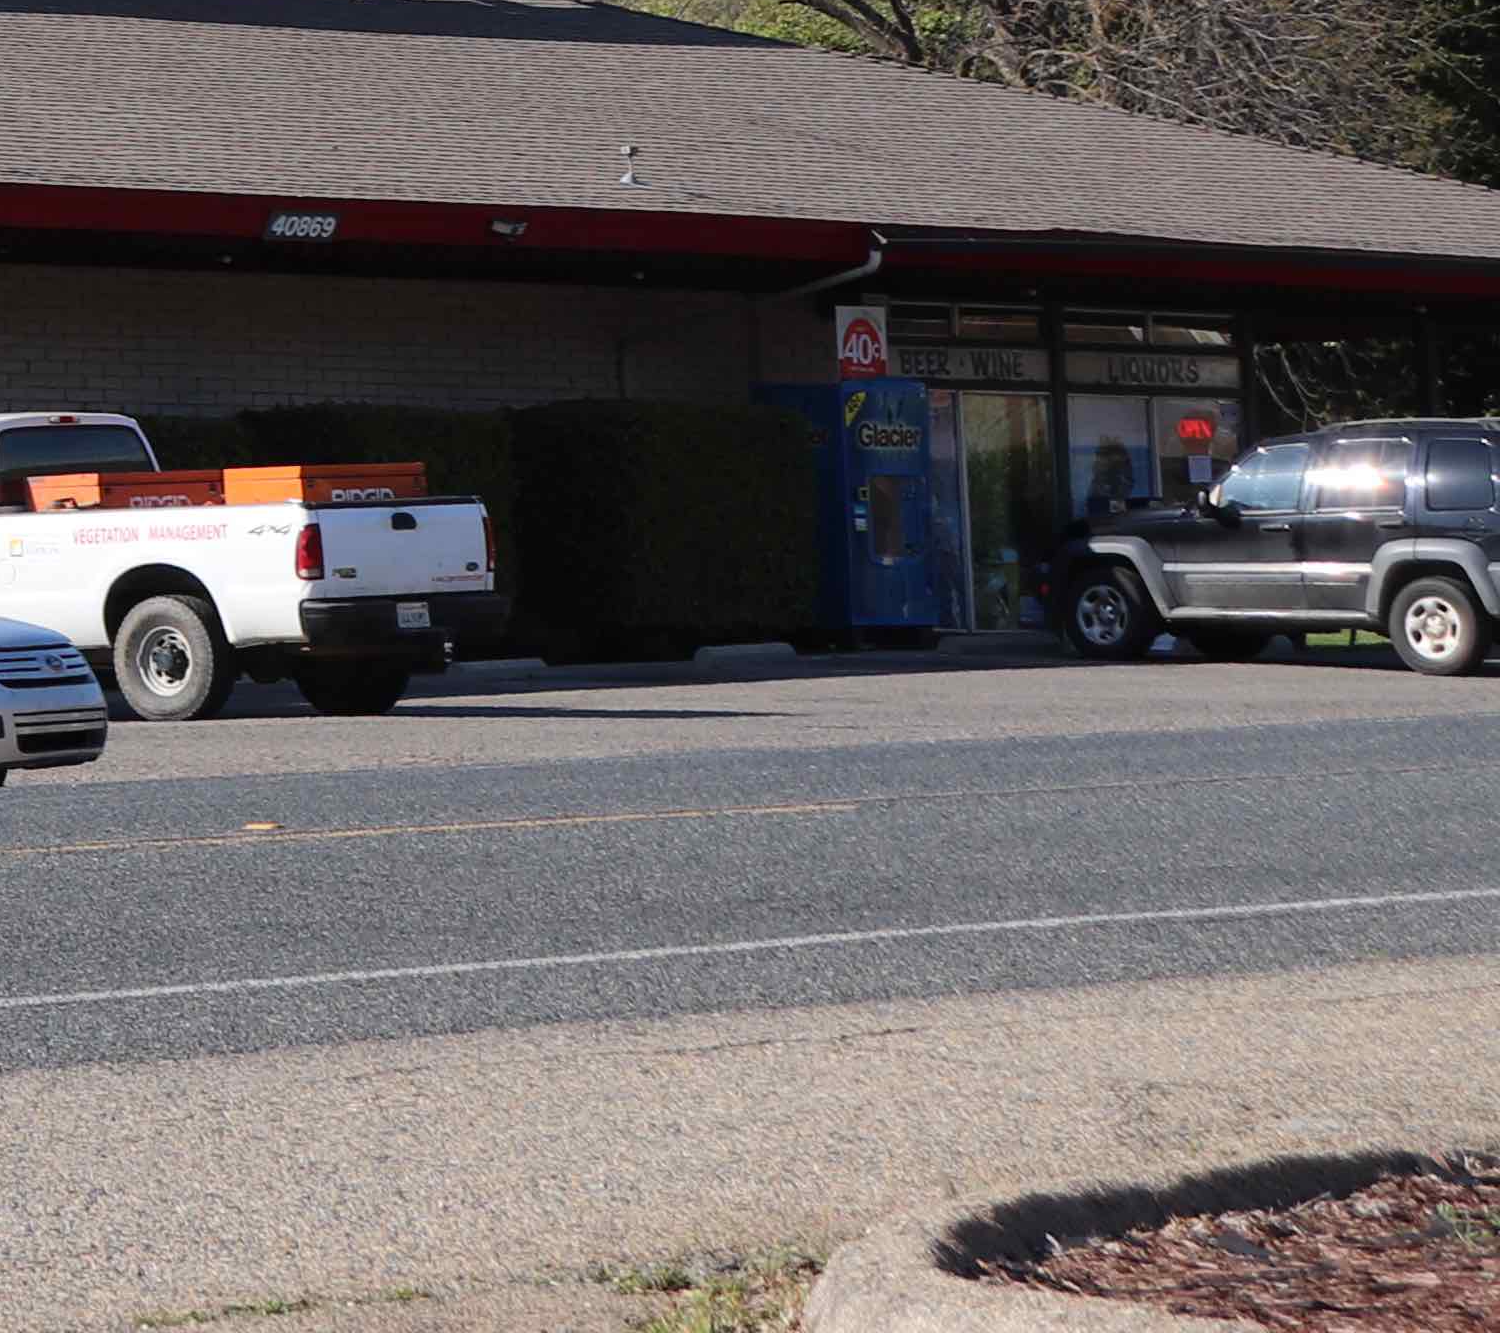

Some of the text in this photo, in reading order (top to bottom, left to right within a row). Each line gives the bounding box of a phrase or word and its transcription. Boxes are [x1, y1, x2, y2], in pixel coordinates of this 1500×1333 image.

[271, 215, 336, 238] 40869
[899, 349, 1023, 379] BEER WINE
[1108, 357, 1200, 383] LIQUORS
[858, 422, 923, 448] Glacier
[72, 523, 228, 545] VEGETATION MANAGEMENT
